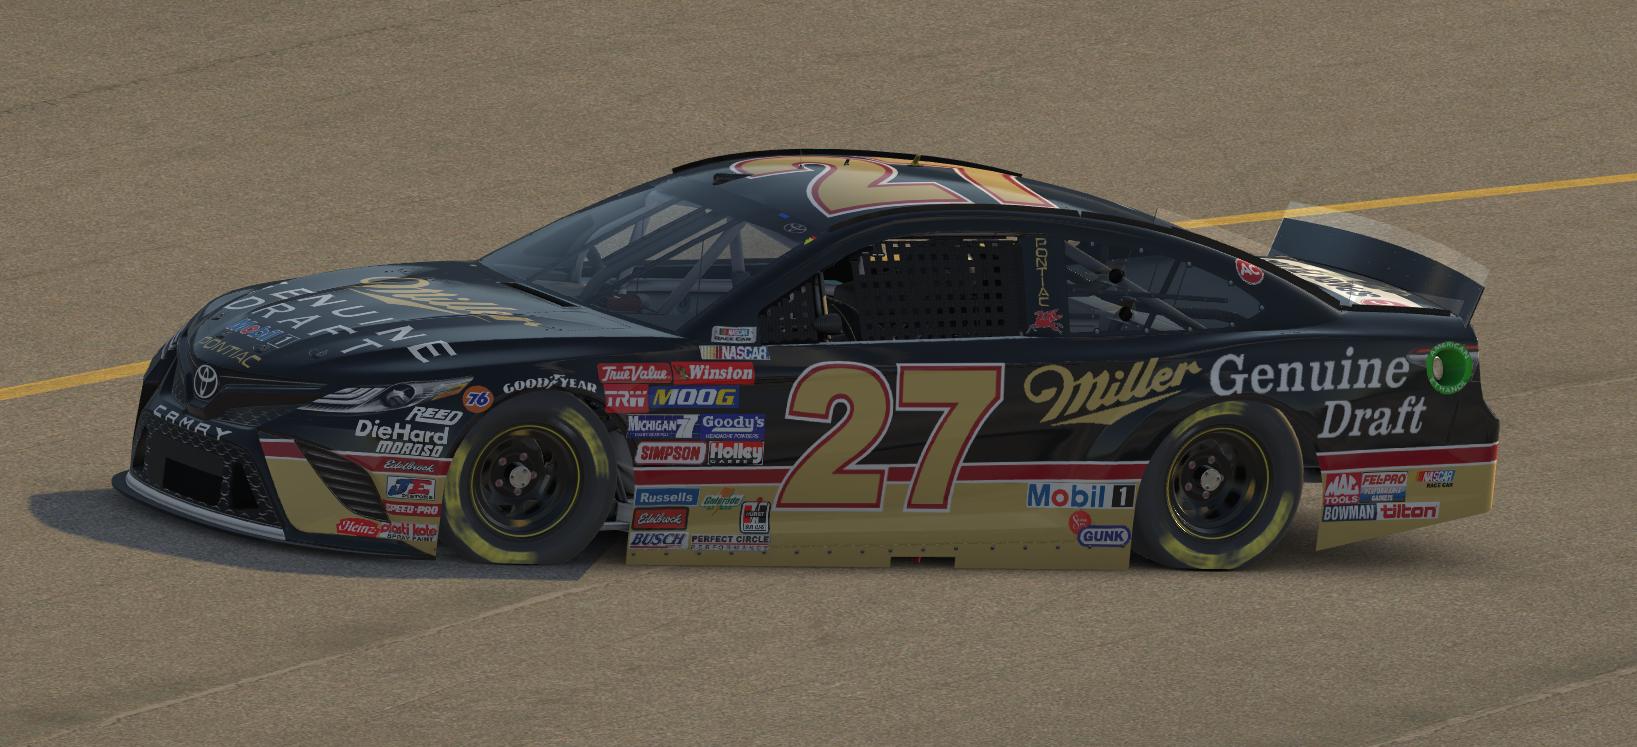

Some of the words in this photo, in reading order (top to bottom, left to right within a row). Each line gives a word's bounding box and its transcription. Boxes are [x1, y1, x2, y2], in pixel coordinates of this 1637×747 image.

[1034, 237, 1050, 307] PONTIAC
[223, 295, 383, 354] DRAFT
[201, 335, 262, 369] PONTIAC
[721, 344, 768, 360] NASCAR
[688, 364, 753, 380] Winston
[1209, 346, 1410, 396] Genuine
[466, 391, 490, 409] 76
[605, 390, 648, 408] TRW
[652, 388, 737, 406] MOOG
[1023, 356, 1202, 426] Miller
[153, 404, 233, 441] CAMRY
[404, 405, 463, 426] REED
[702, 415, 765, 433] Goody's
[1317, 394, 1427, 439] Draft
[354, 418, 450, 445] DieHard
[770, 360, 1005, 513] 27
[375, 440, 444, 458] MOROSO
[640, 445, 701, 461] SIMPSON
[710, 442, 763, 464] Holley
[1324, 473, 1360, 497] MAC
[1422, 470, 1455, 483] NASCAR
[639, 491, 693, 503] Russells
[1027, 483, 1106, 508] Mobil
[1324, 495, 1360, 504] TOOLS
[1323, 504, 1376, 521] BOWMAN
[1380, 503, 1437, 519] tilton
[338, 520, 376, 535] Heinz
[1083, 530, 1125, 542] GUNK
[630, 532, 686, 546] BUSCH
[691, 535, 734, 543] PERFECT
[735, 535, 770, 544] CIRCLE
